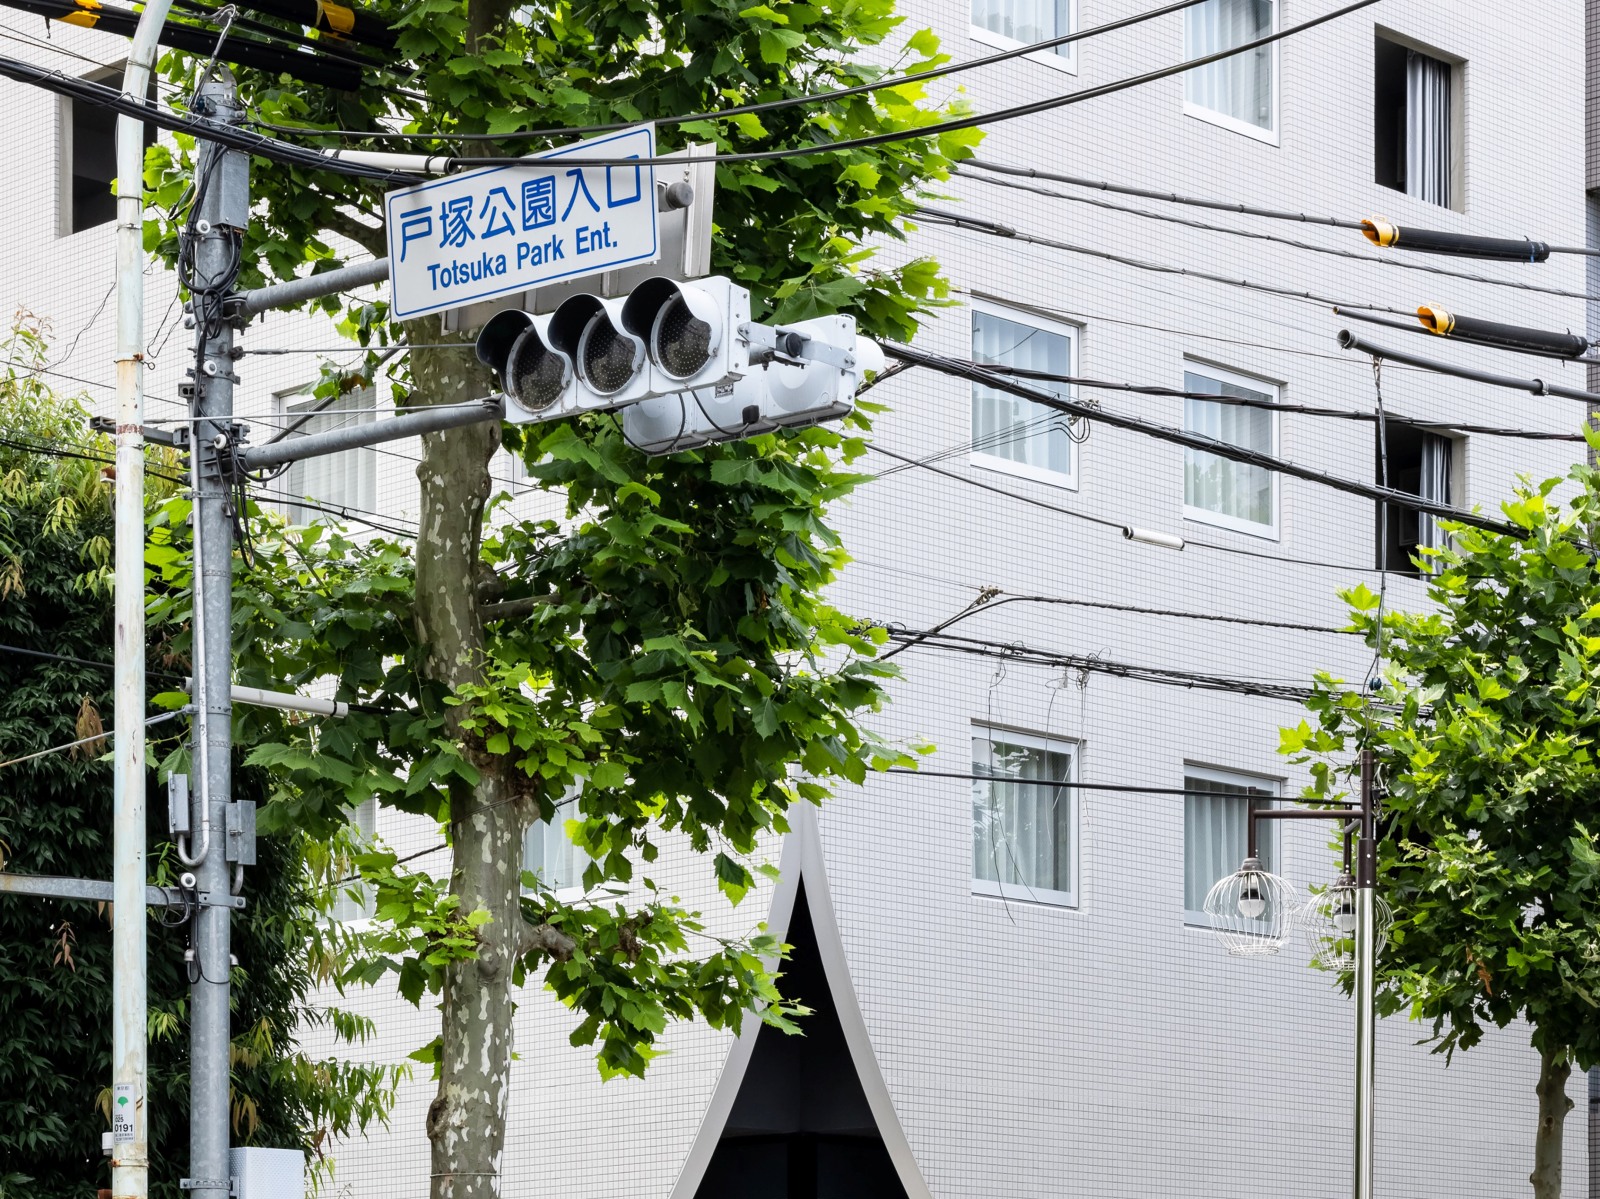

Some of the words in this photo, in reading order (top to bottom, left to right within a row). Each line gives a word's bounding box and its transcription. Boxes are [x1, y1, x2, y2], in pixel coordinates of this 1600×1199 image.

[400, 154, 642, 263] 戸塚公園入口
[427, 252, 507, 291] Totsuka
[517, 234, 565, 270] Park
[576, 221, 618, 256] Ent.
[115, 1124, 133, 1132] 0191
